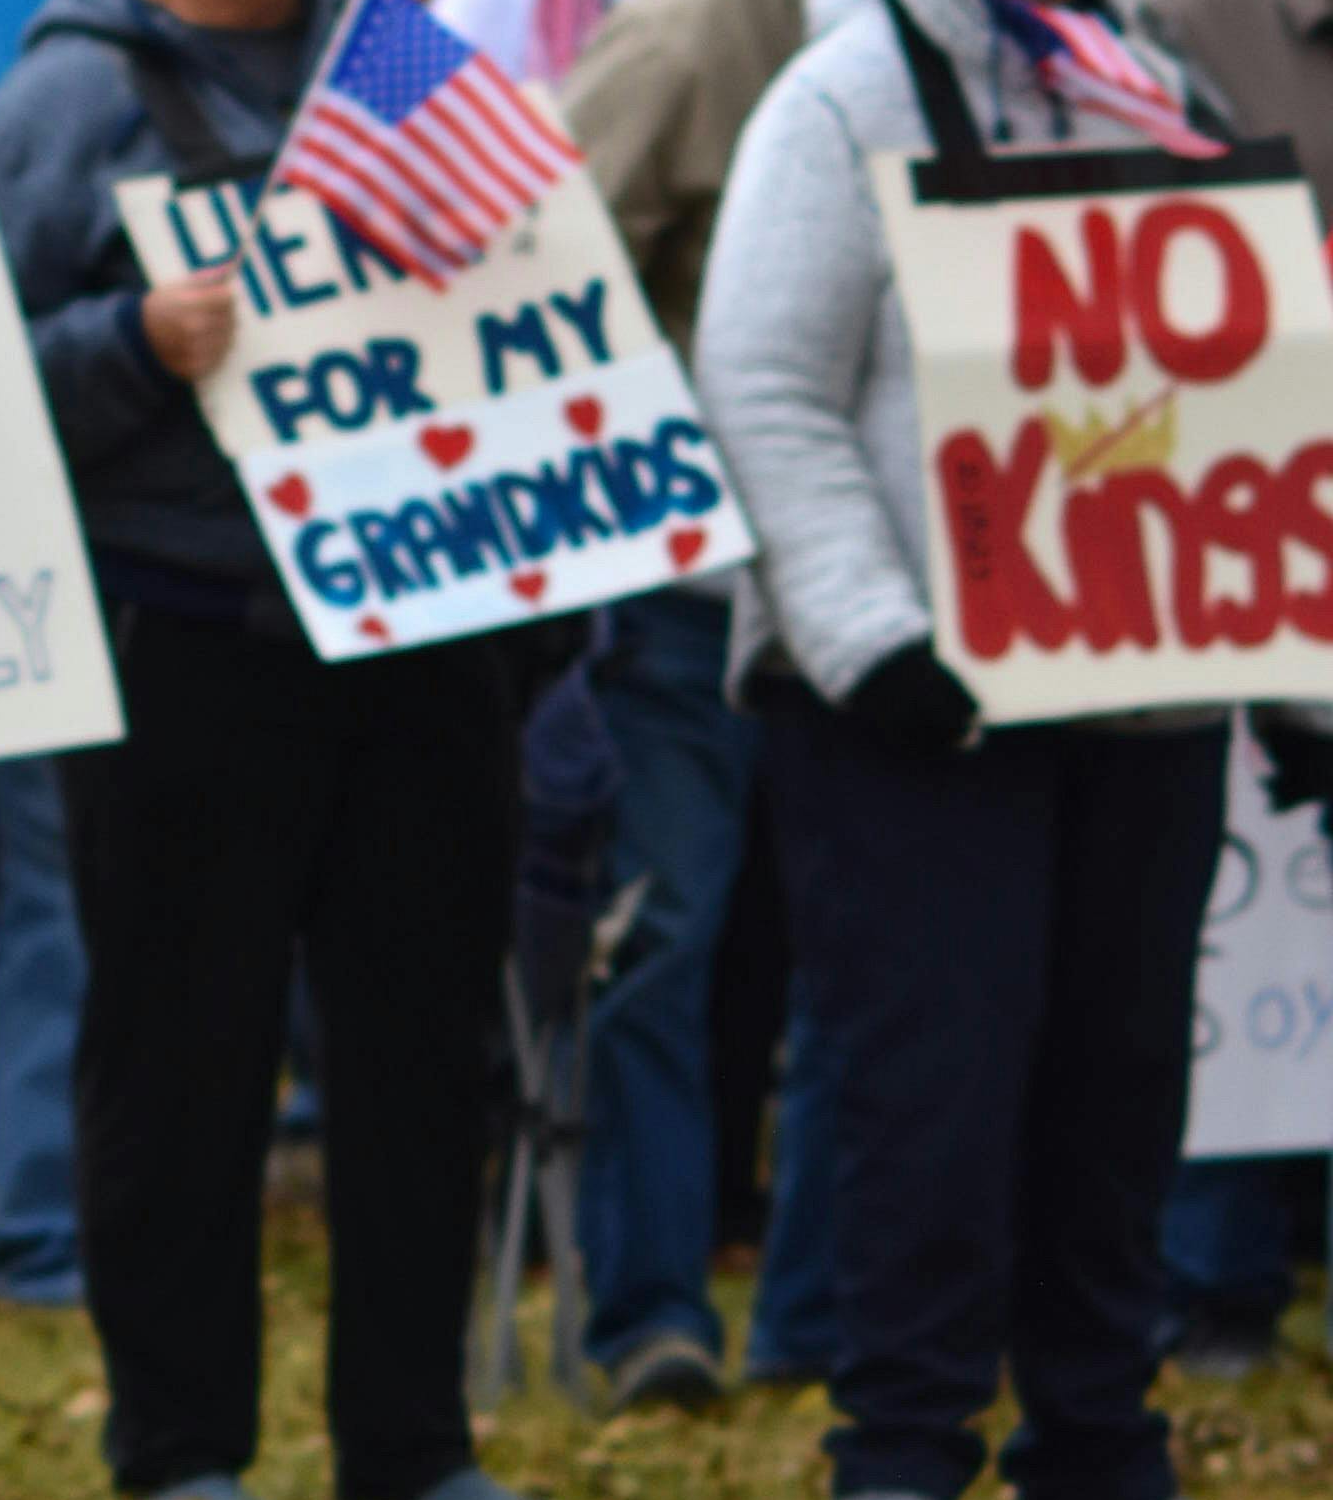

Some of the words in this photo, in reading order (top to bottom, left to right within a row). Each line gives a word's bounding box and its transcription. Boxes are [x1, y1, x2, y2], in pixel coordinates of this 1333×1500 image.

[247, 336, 434, 444] FOR
[475, 276, 614, 396] MY
[1011, 197, 1271, 393] NO
[291, 416, 722, 609] GRANDKIDS
